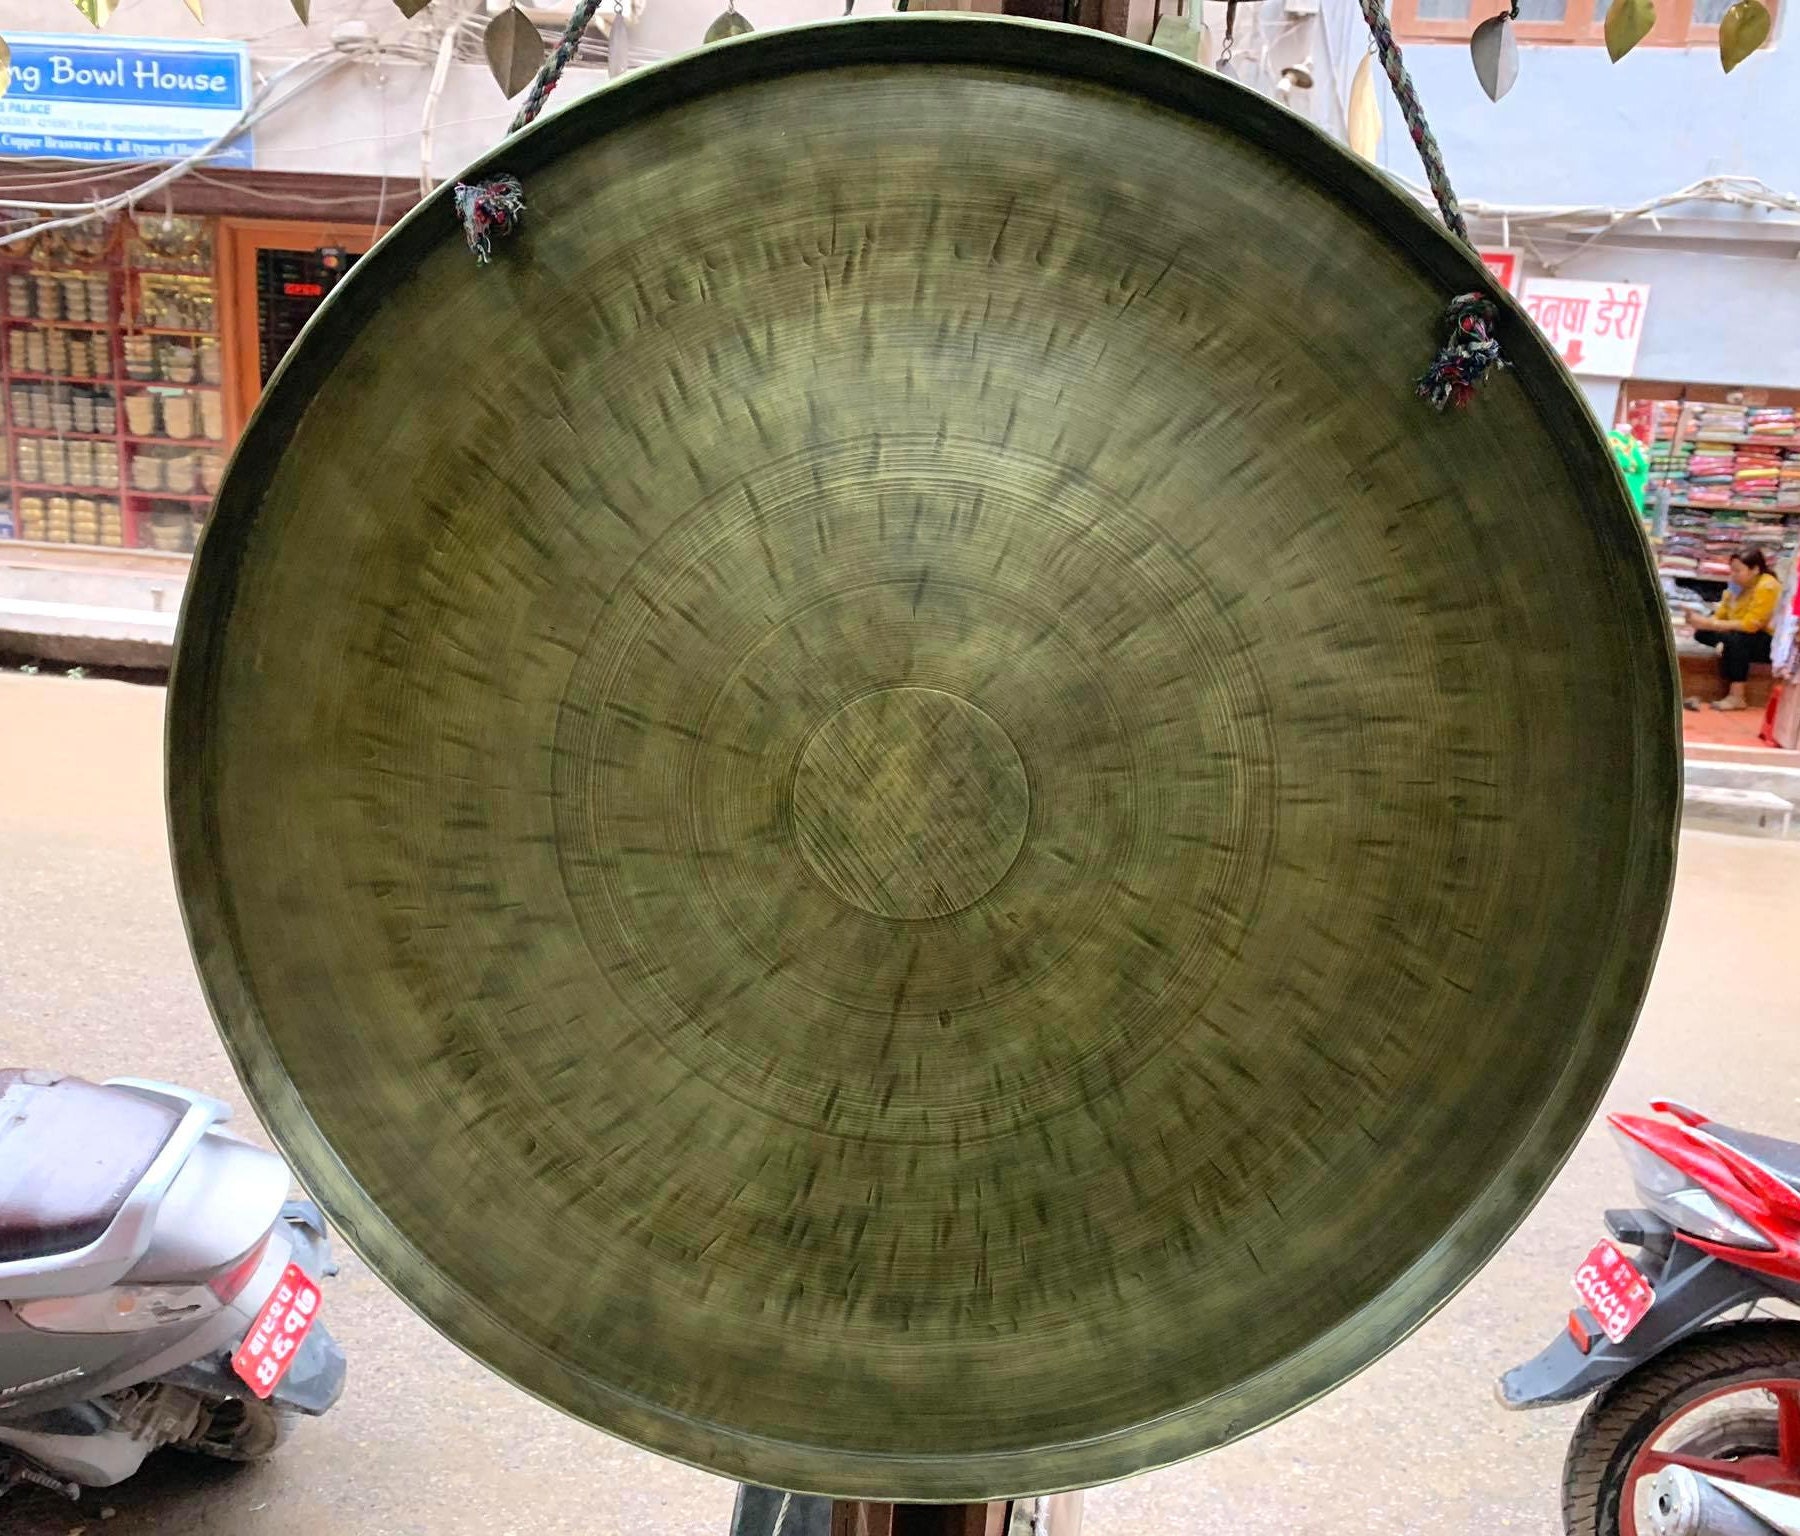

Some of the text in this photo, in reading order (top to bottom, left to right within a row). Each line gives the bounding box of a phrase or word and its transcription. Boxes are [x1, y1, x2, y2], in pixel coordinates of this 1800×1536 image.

[48, 55, 125, 87] Bowl
[133, 60, 228, 92] House
[8, 102, 51, 115] PALACE
[1594, 287, 1643, 340] डेरी
